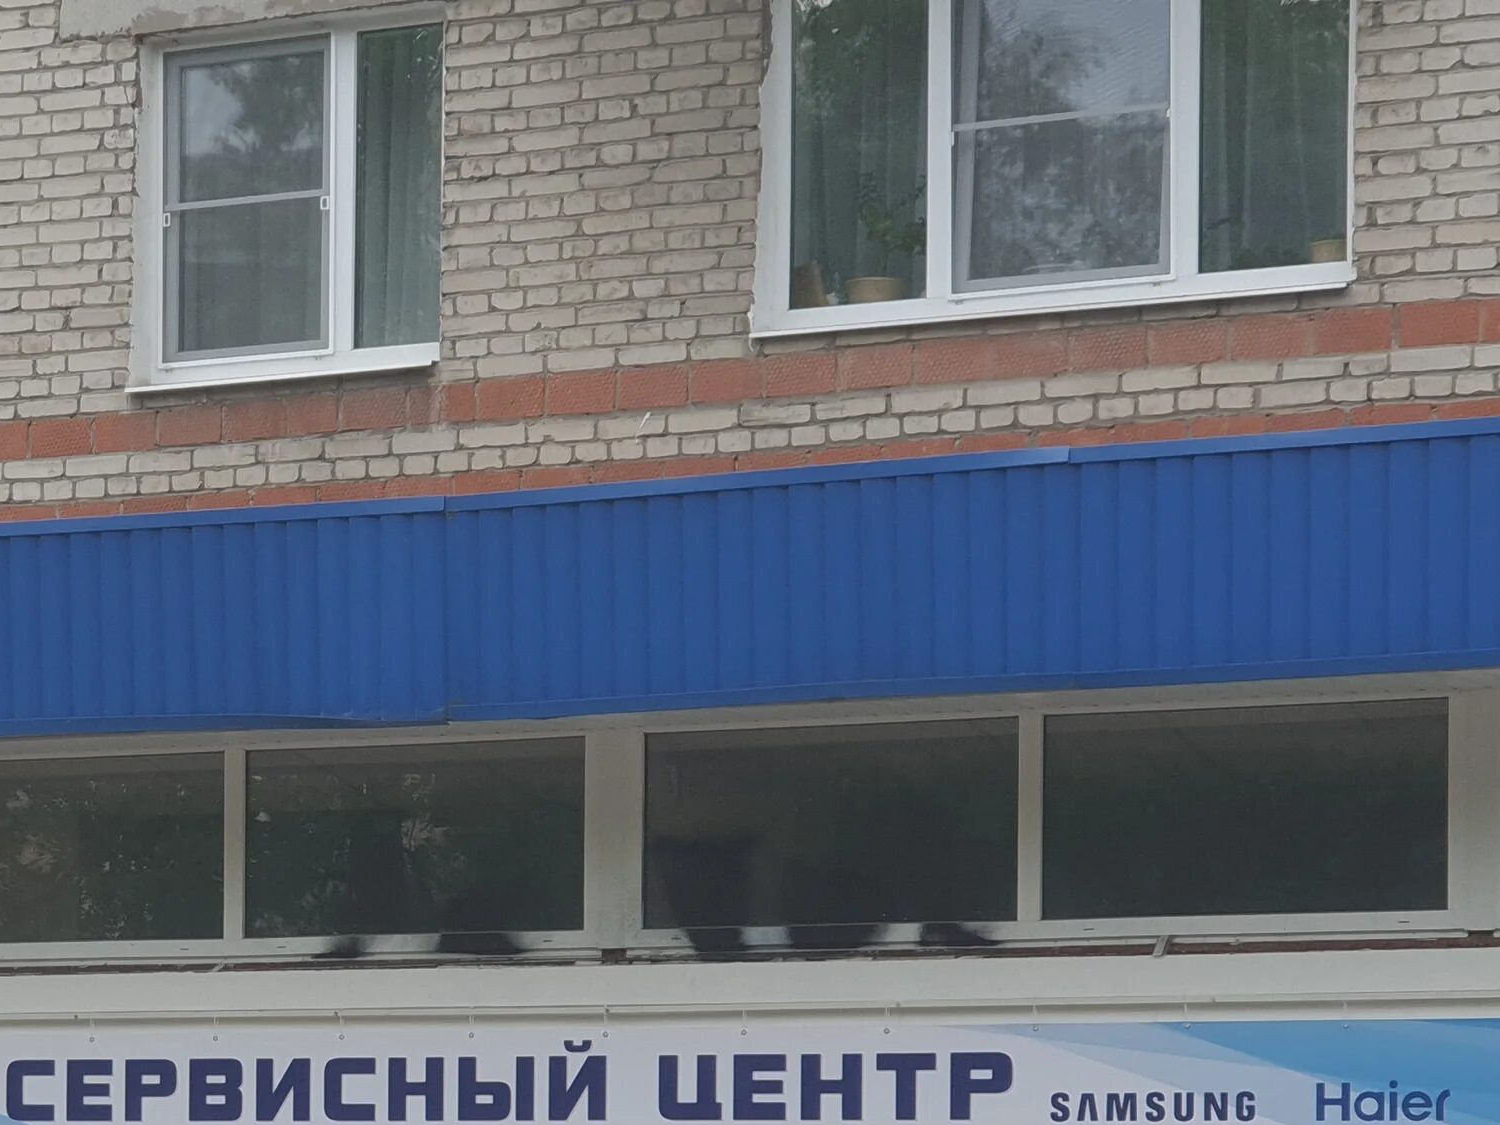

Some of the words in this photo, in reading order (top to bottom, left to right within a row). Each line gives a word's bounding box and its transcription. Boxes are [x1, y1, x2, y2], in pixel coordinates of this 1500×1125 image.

[6, 1040, 607, 1122] СЕРВИСНЫЙ
[658, 1052, 1013, 1122] ЦЕНТР
[1315, 1080, 1451, 1121] Haier
[1050, 1091, 1256, 1122] SAMSUNG
